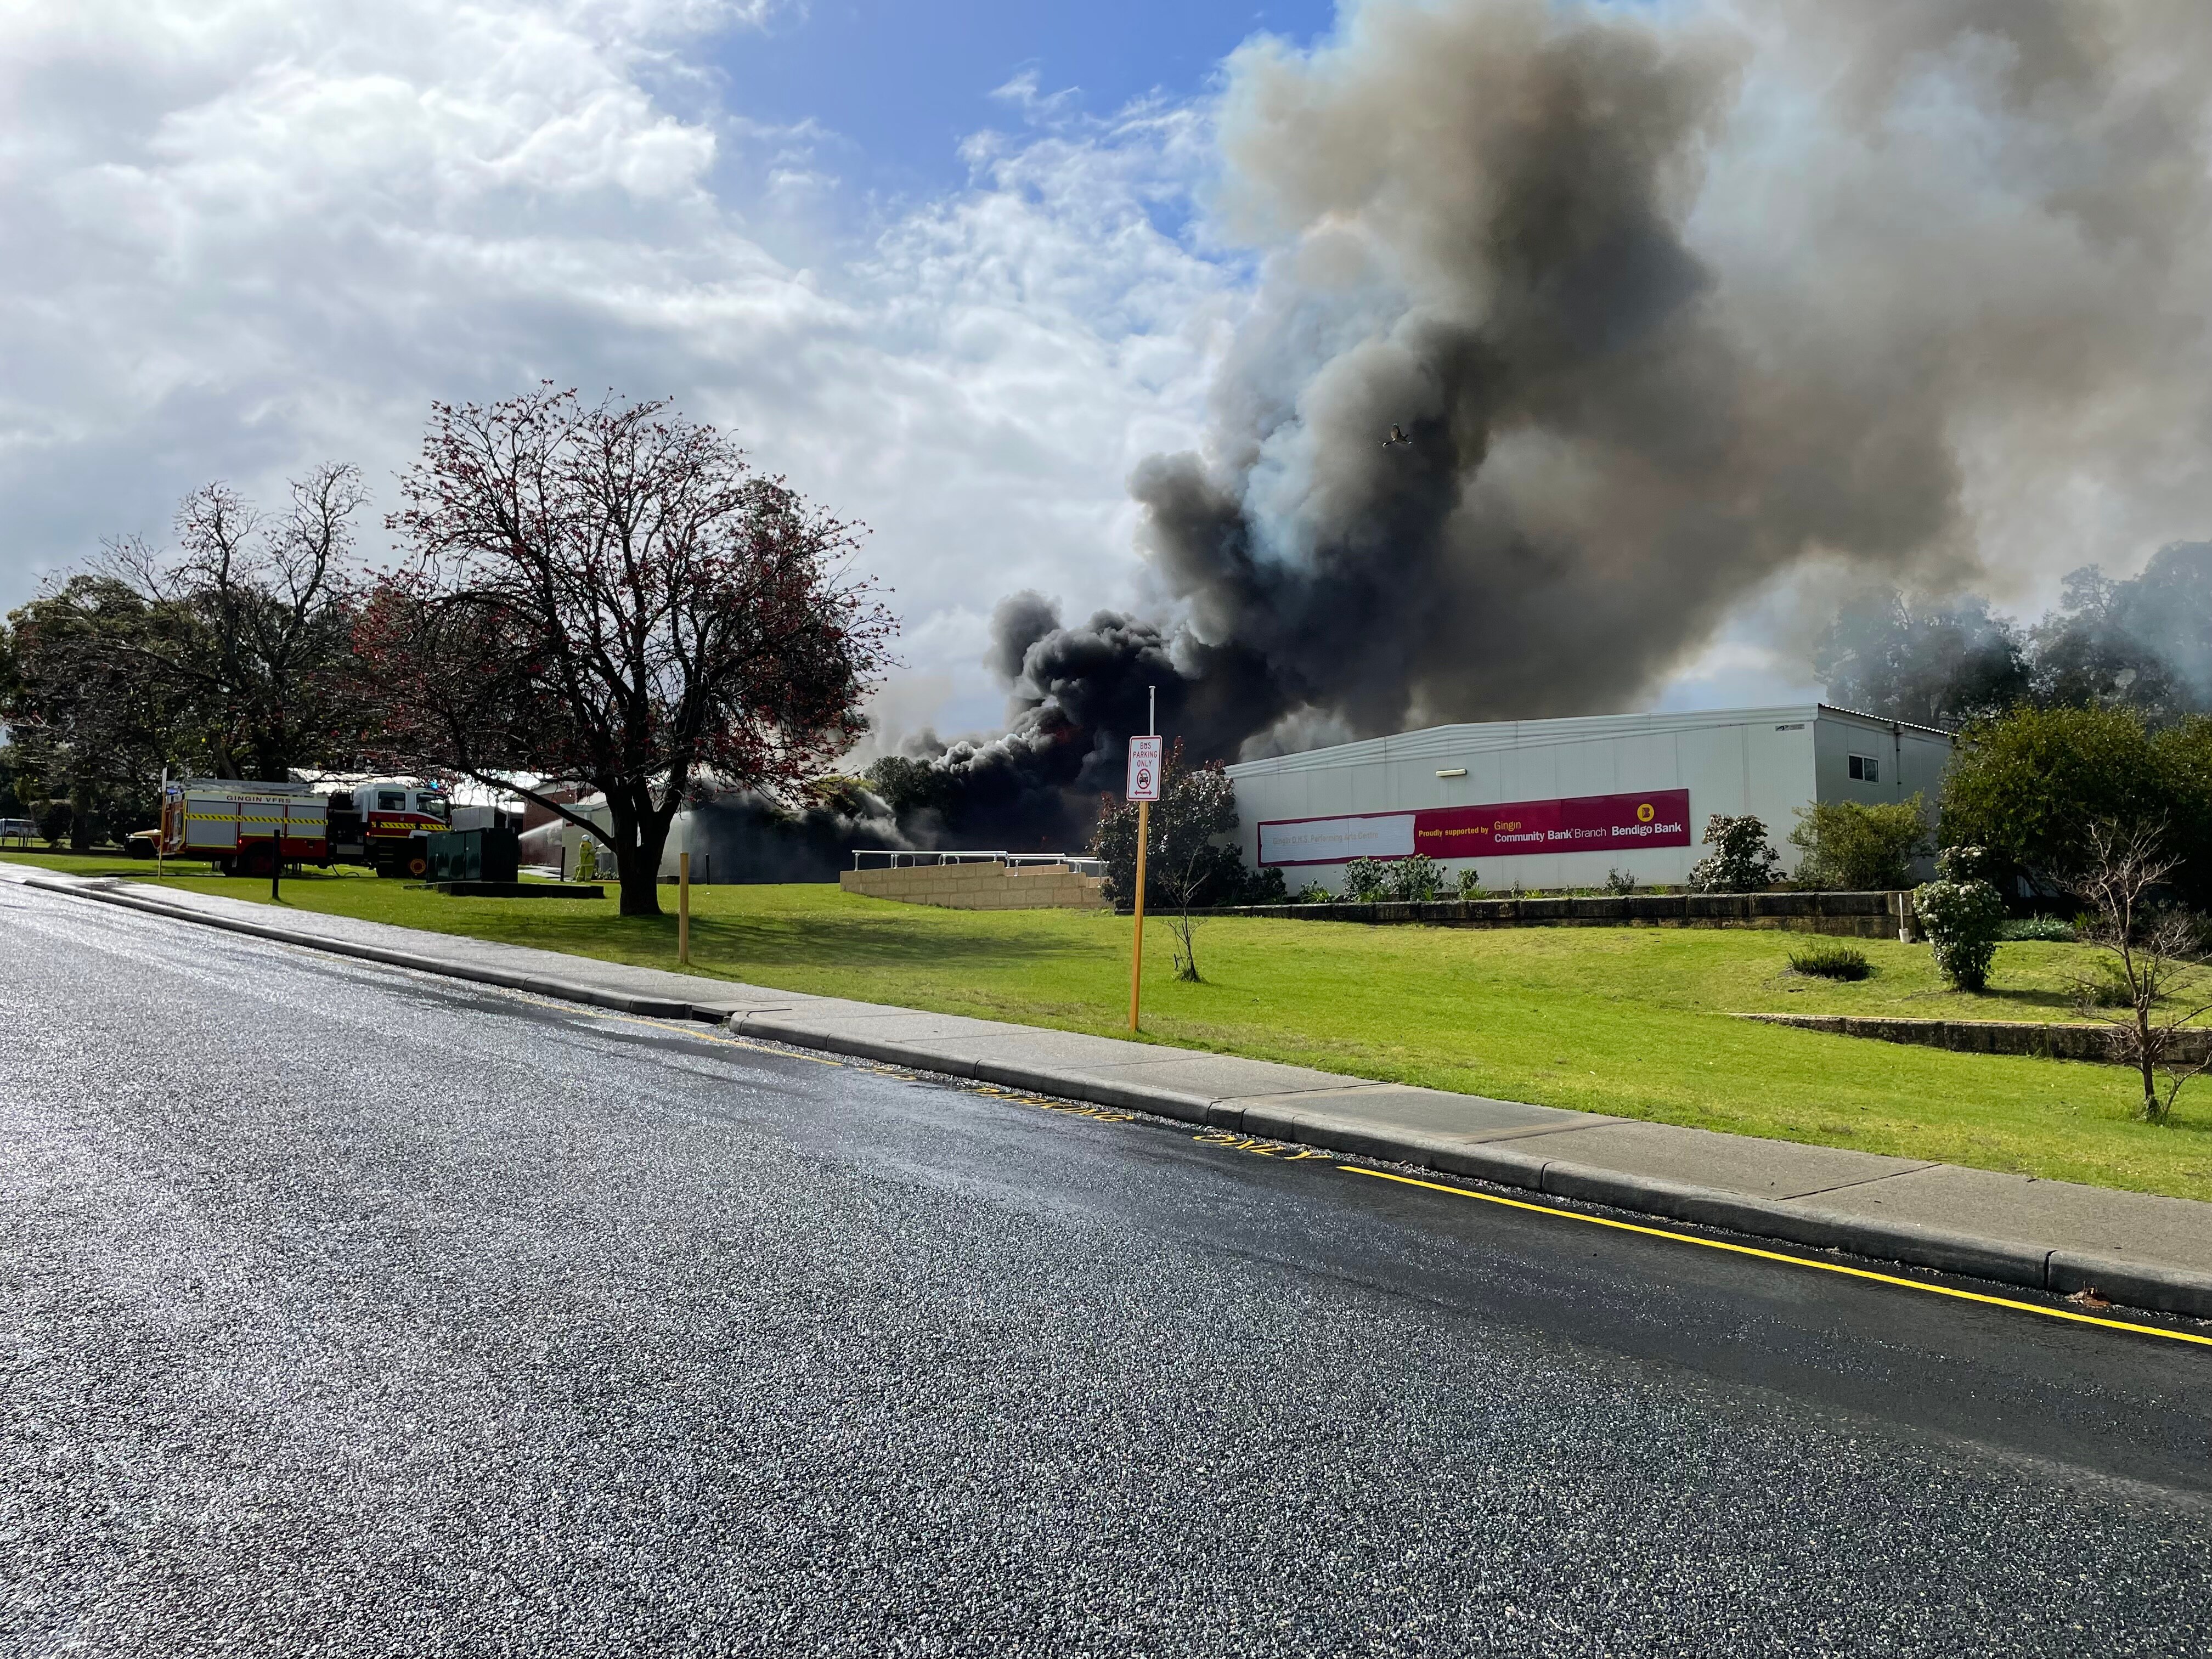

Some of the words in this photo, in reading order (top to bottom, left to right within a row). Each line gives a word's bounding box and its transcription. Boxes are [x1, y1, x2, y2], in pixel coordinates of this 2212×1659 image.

[1419, 829, 1443, 838] Proudly
[1445, 827, 1479, 836] supported
[1481, 826, 1489, 834] by
[1494, 821, 1521, 832] Gingin
[1494, 831, 1545, 843] Community
[1574, 827, 1607, 838] Branch
[1611, 825, 1652, 836] Bendigo
[1655, 822, 1682, 833] Bank
